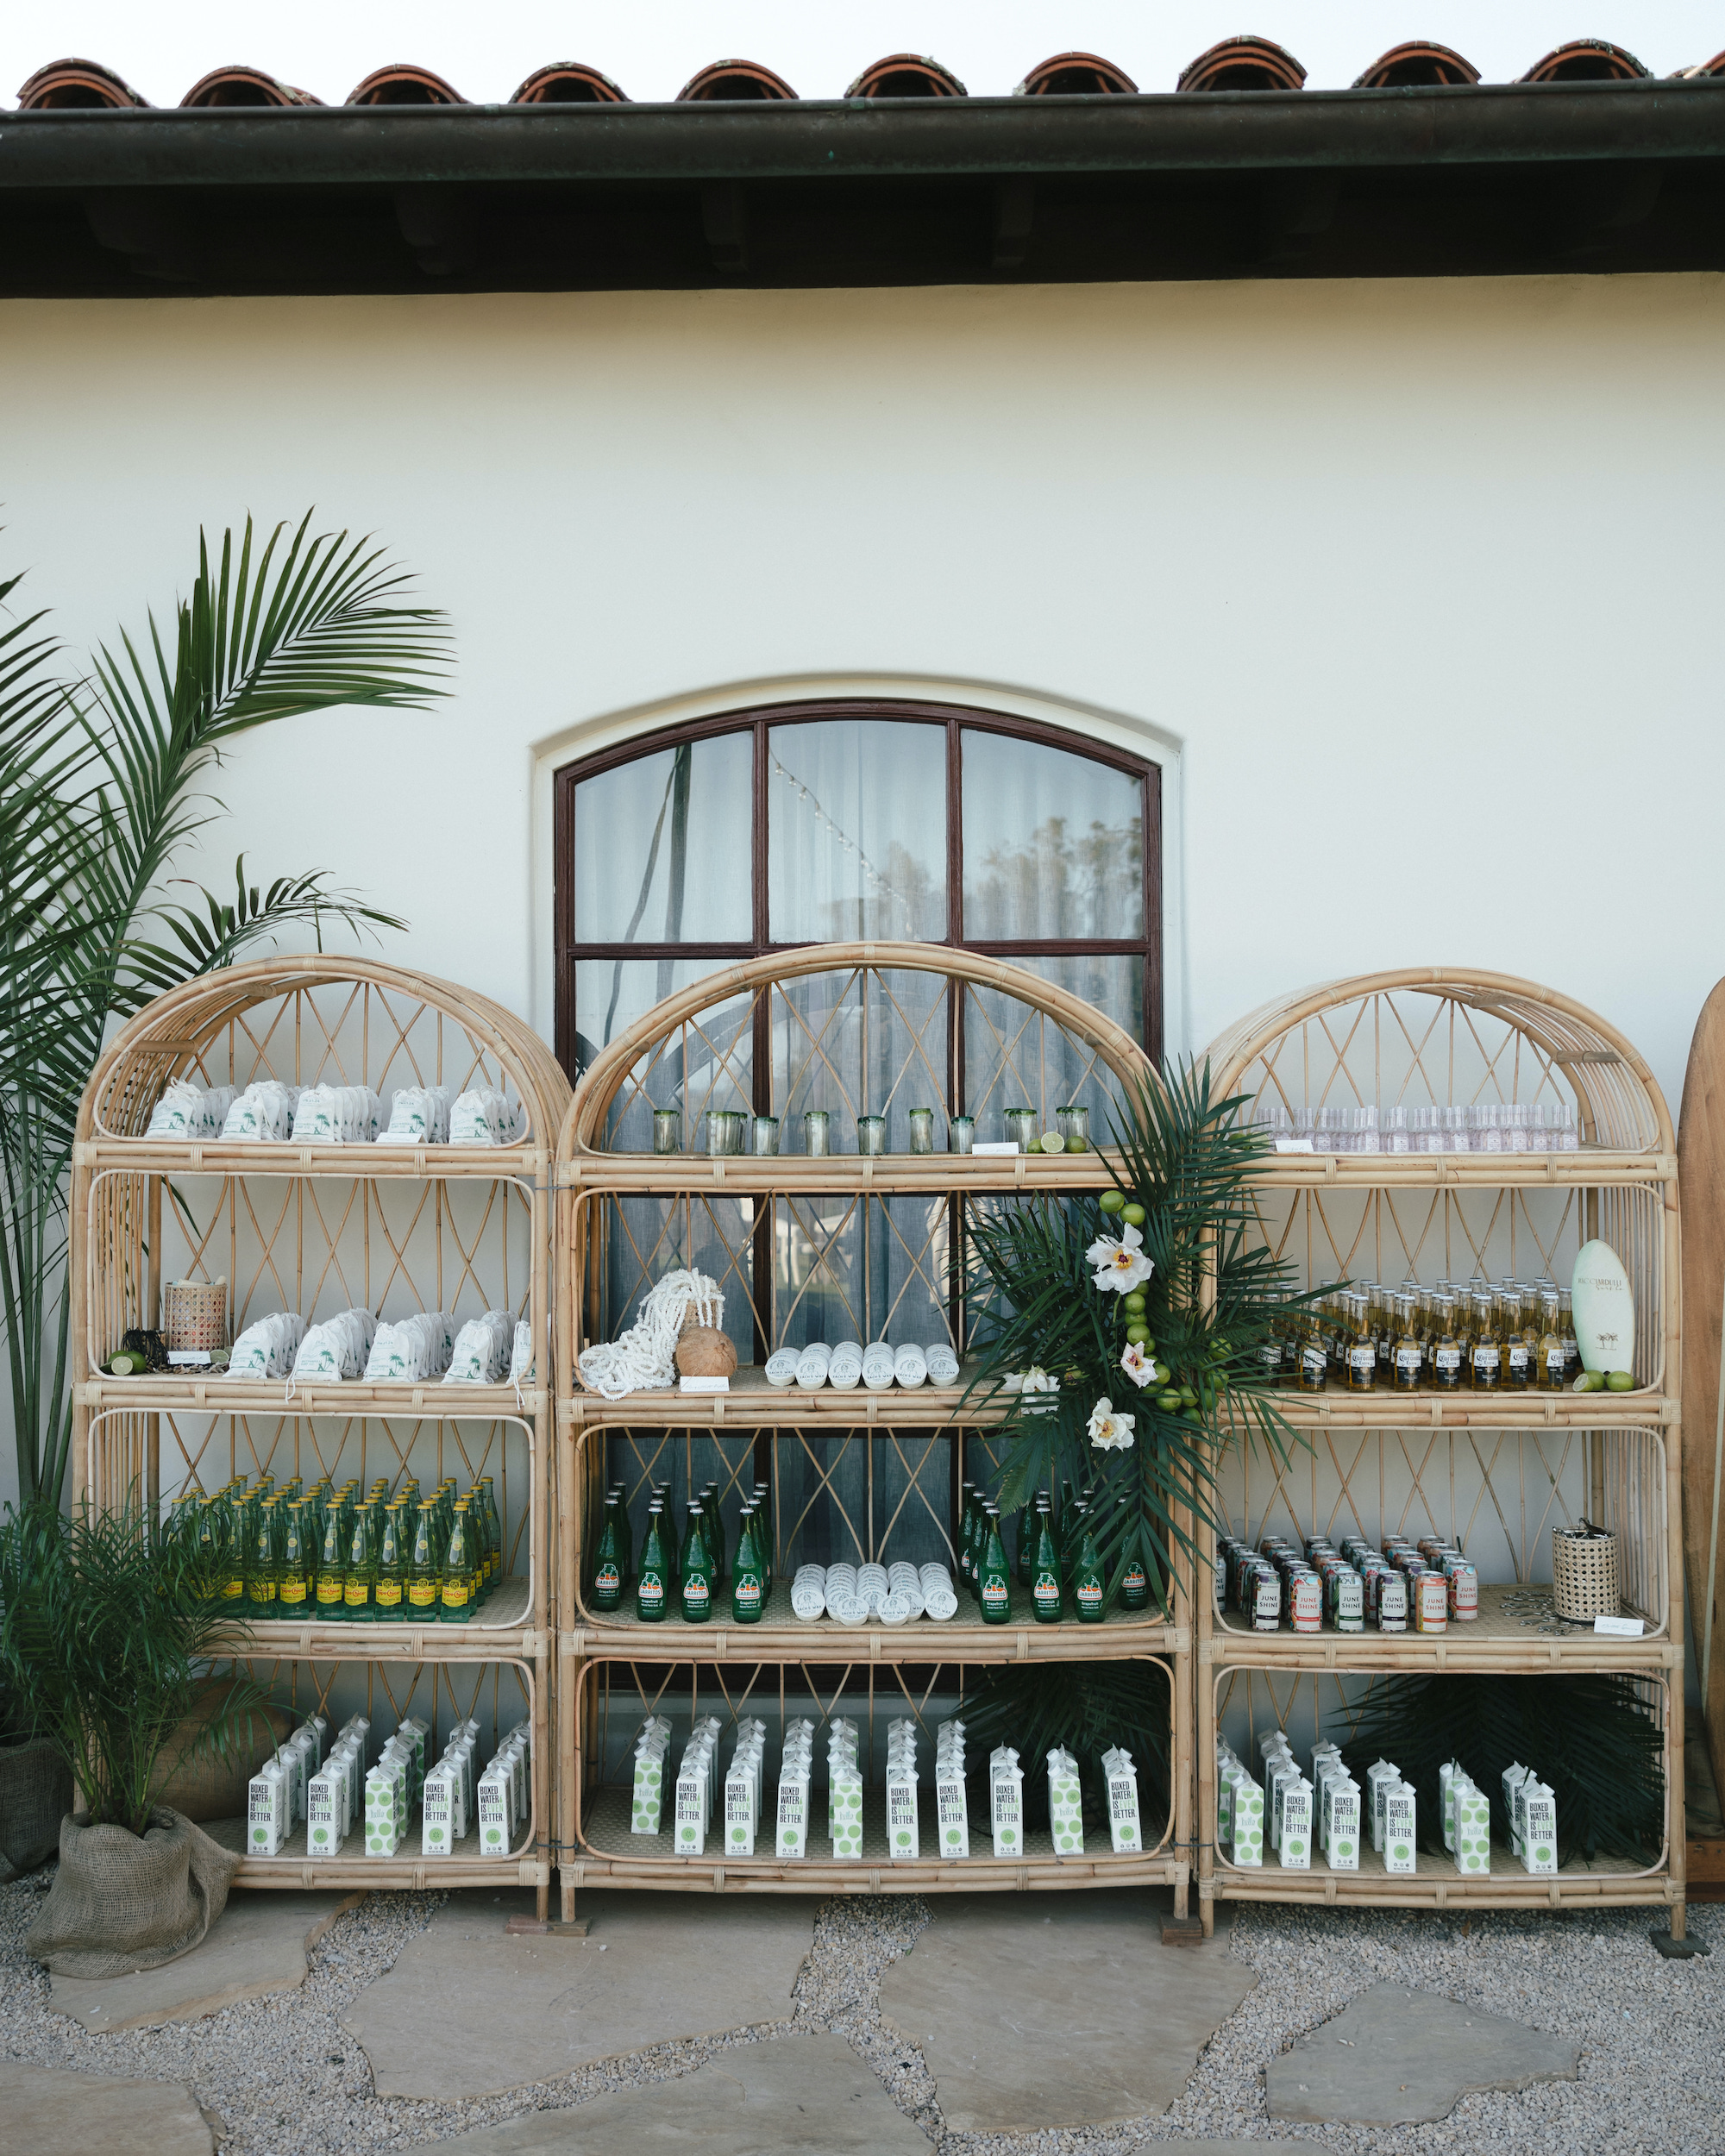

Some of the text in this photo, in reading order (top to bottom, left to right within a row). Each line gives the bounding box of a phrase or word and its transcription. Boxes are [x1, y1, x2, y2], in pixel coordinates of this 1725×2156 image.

[251, 1784, 268, 1794] BOXED
[310, 1784, 328, 1794] BOXED
[426, 1784, 444, 1793] BOXED
[679, 1783, 697, 1792] BOXED
[939, 1785, 957, 1794] BOXED
[996, 1785, 1014, 1794] BOXED
[1111, 1781, 1130, 1789] BOXED
[781, 1787, 799, 1796] BOXED
[891, 1788, 909, 1796] BOXED
[1112, 1790, 1131, 1799] WATER
[251, 1794, 268, 1802] WATER
[310, 1794, 329, 1802] WATER
[426, 1794, 445, 1802] WATER
[940, 1795, 958, 1803] WATER
[996, 1795, 1015, 1803] WATER
[1287, 1796, 1305, 1804] BOXED
[1335, 1797, 1353, 1806] BOXED
[251, 1803, 273, 1812] IS EVEN
[310, 1802, 332, 1812] IS EVEN
[425, 1802, 448, 1811] IS EVEN
[480, 1804, 504, 1813] IS EVEN
[684, 1802, 700, 1811] EVEN
[728, 1802, 750, 1811] IS EVEN
[940, 1804, 963, 1813] IS EVEN
[996, 1803, 1019, 1813] IS EVEN
[1113, 1800, 1136, 1808] IS EVEN
[1389, 1800, 1408, 1808] BOXED
[780, 1805, 803, 1814] IS EVEN
[891, 1806, 914, 1815] IS EVEN
[1113, 1809, 1137, 1818] BETTER.
[1287, 1805, 1306, 1814] WATER
[1389, 1809, 1408, 1818] WATER
[250, 1812, 272, 1821] BETTER.
[310, 1812, 332, 1821] BETTER.
[425, 1812, 448, 1821] BETTER.
[481, 1813, 504, 1822] BETTER.
[678, 1811, 700, 1820] BETTER.
[728, 1812, 750, 1821] BETTER.
[780, 1814, 802, 1823] BETTER.
[892, 1815, 914, 1824] BETTER.
[941, 1813, 964, 1822] BETTER.
[996, 1813, 1019, 1822] BETTER.
[1286, 1814, 1309, 1823] IS EVEN
[1341, 1815, 1358, 1825] EVEN
[1396, 1819, 1413, 1827] EVEN
[1537, 1821, 1553, 1830] EVEN
[1286, 1824, 1308, 1833] BETTER.
[1334, 1825, 1357, 1834] BETTER.
[1389, 1828, 1413, 1837] BETTER.
[1531, 1831, 1553, 1839] BETTER.
